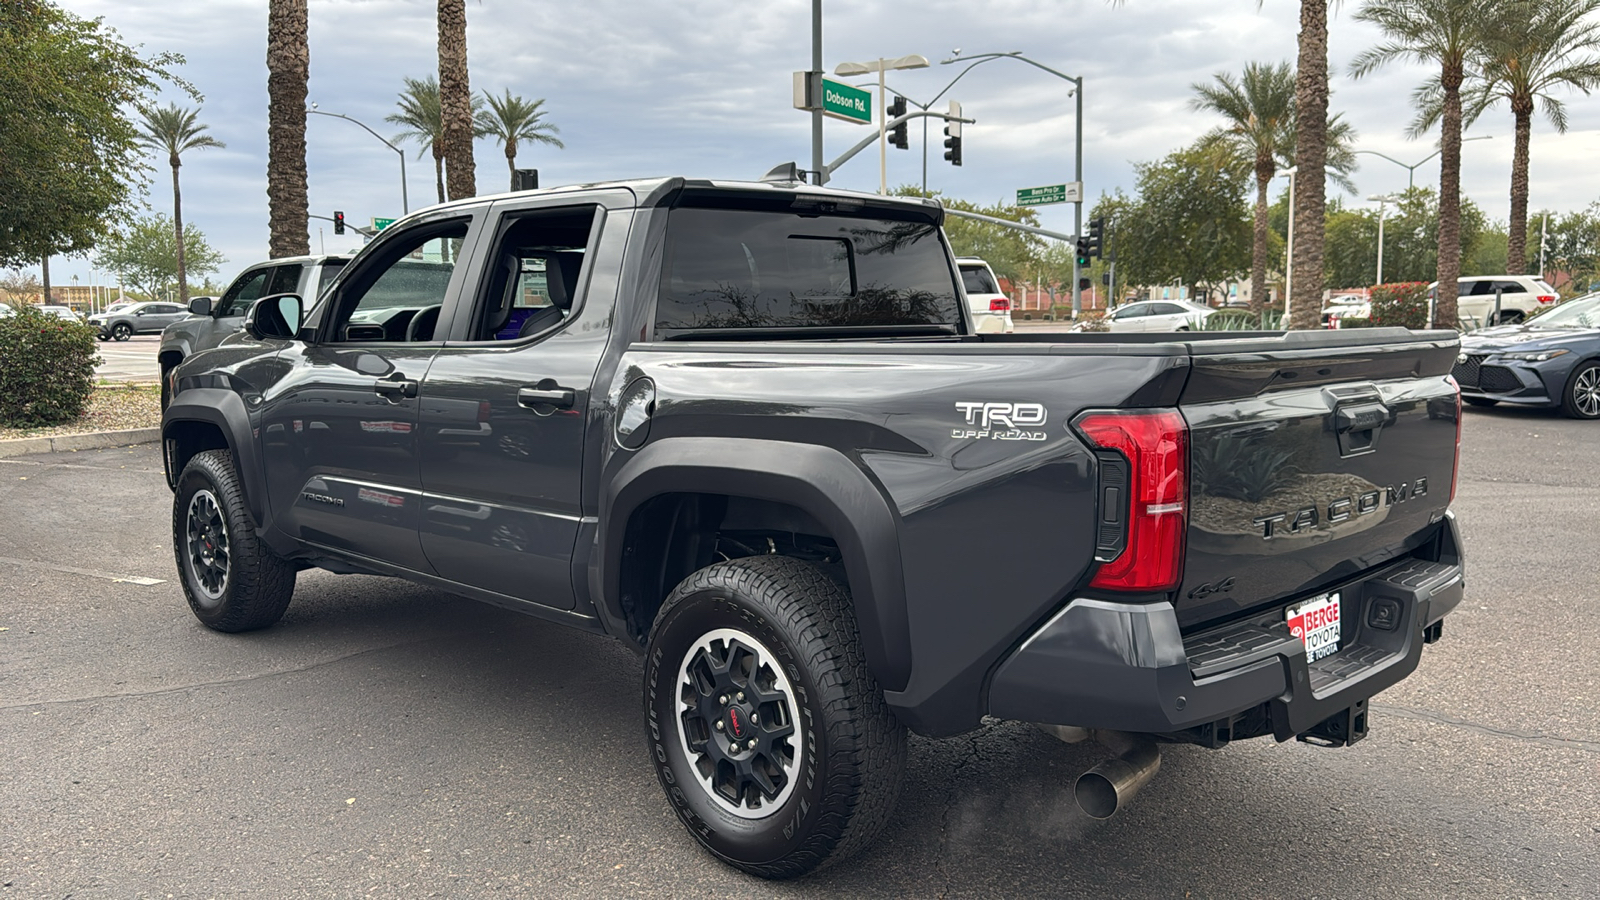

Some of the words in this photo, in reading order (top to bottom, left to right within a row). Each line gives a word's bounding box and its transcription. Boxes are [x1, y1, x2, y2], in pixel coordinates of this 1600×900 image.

[826, 89, 853, 108] Dobson
[855, 98, 866, 112] Rd.
[955, 402, 1047, 430] TRD
[951, 429, 990, 439] OFF
[991, 430, 1047, 440] ROAD
[301, 491, 346, 507] TACOMA
[1253, 476, 1428, 540] TACOMA
[1305, 603, 1339, 632] BERGE
[1307, 625, 1340, 649] TOYOTA
[1315, 643, 1338, 660] TOYOTA
